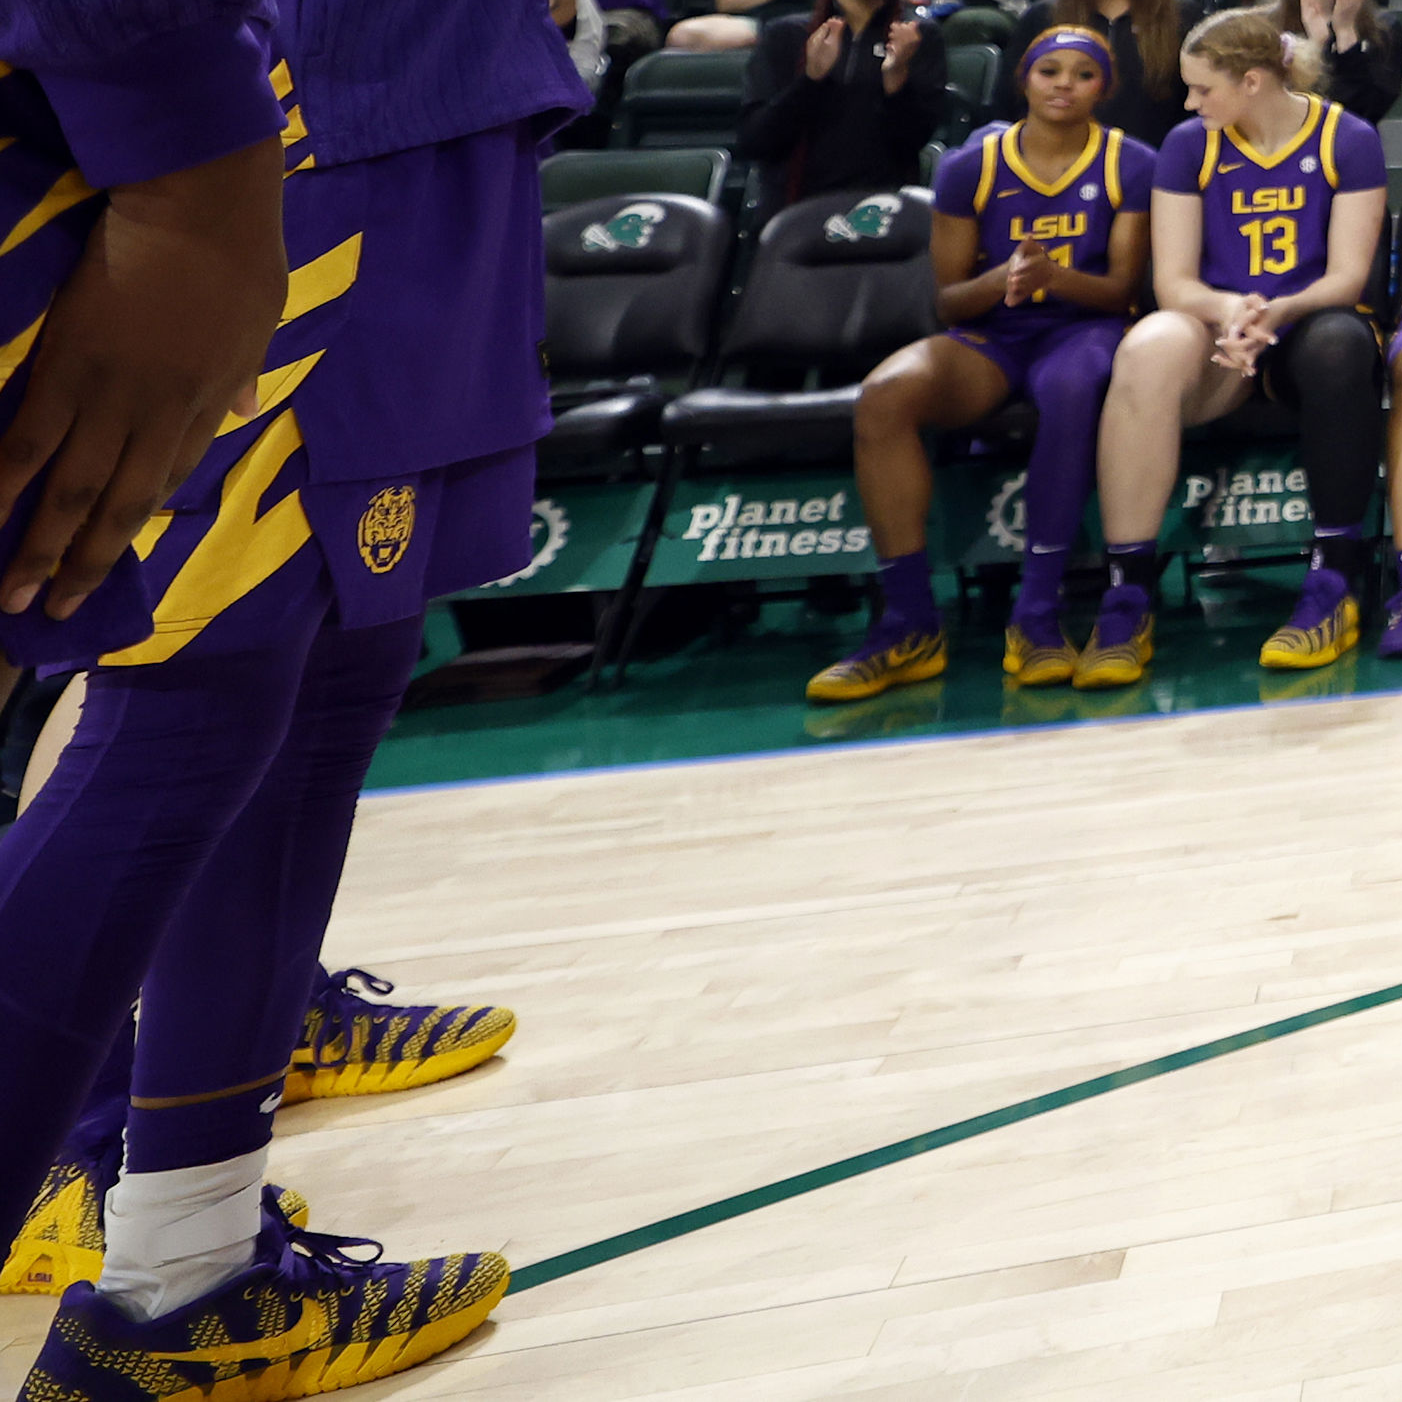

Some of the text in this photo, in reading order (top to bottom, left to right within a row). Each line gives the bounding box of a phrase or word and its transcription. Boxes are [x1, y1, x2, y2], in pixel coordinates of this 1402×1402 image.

[1231, 184, 1307, 214] LSU
[1009, 211, 1087, 241] LSU
[1239, 216, 1298, 276] 13
[1182, 469, 1307, 508] plane
[682, 492, 847, 540] planet
[1203, 496, 1314, 527] fitne
[697, 526, 871, 561] fitness
